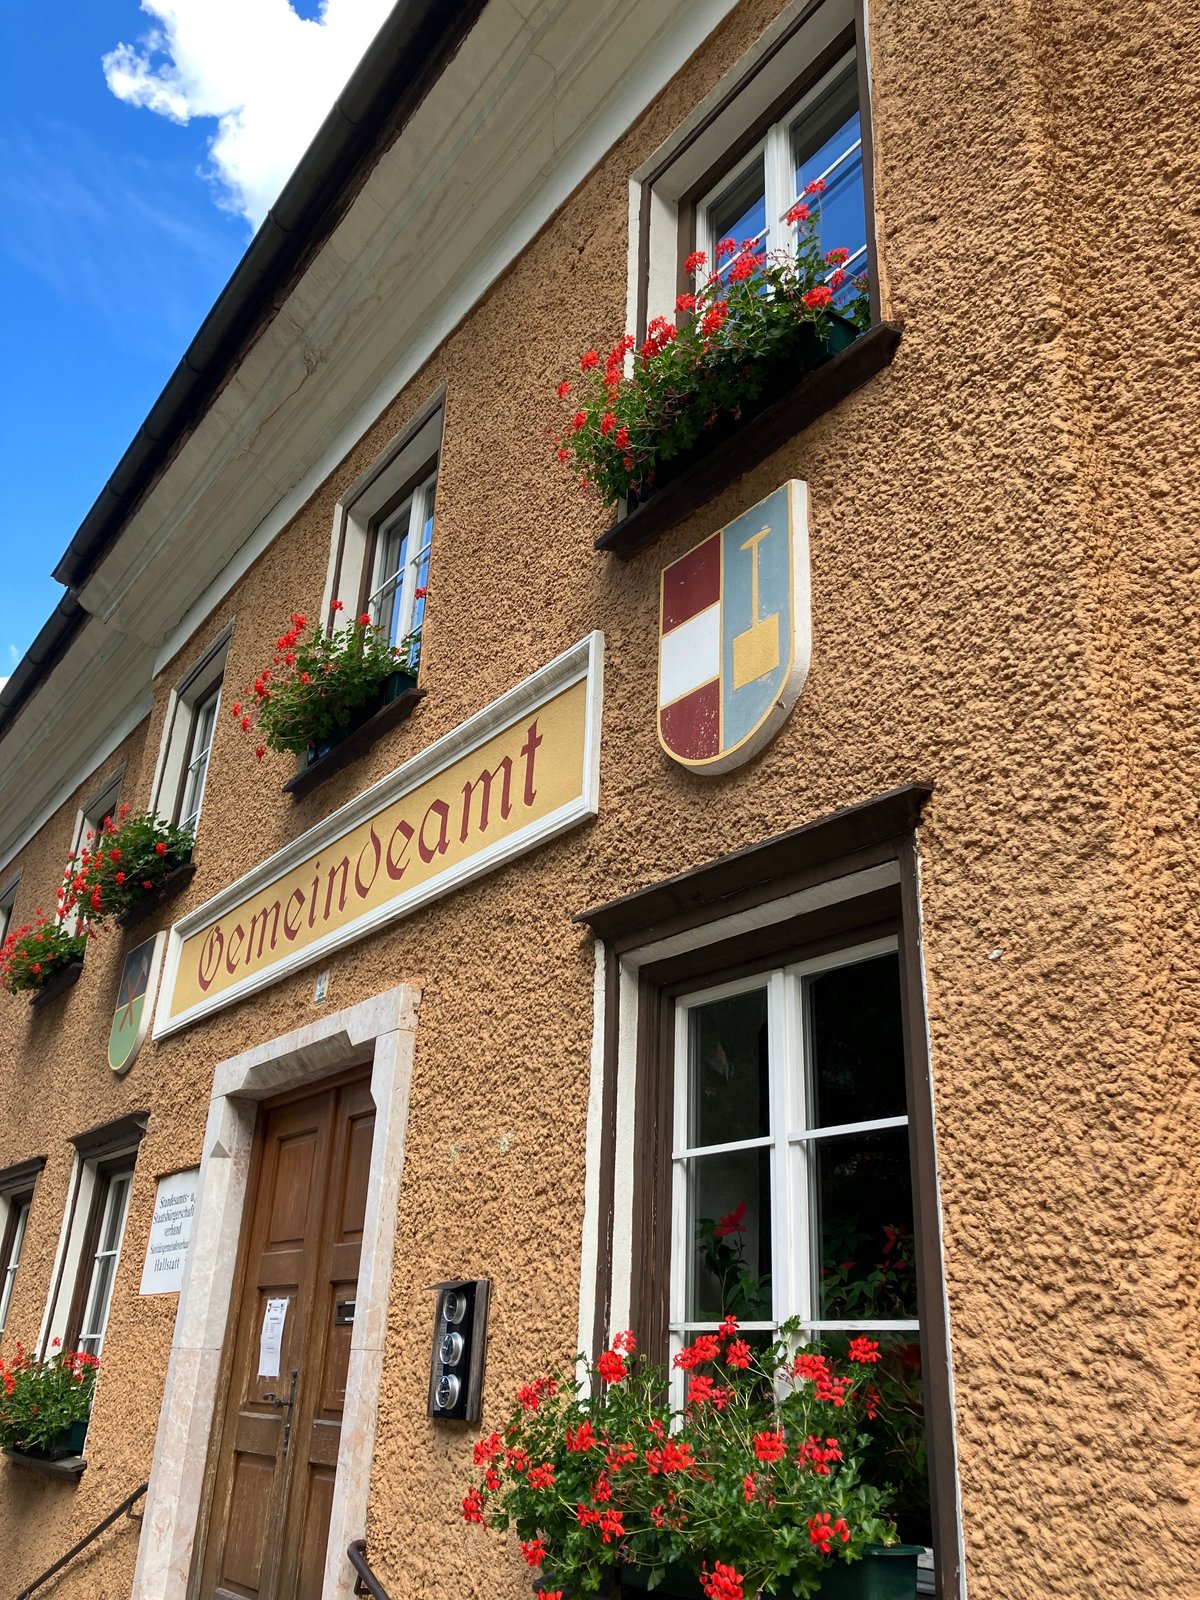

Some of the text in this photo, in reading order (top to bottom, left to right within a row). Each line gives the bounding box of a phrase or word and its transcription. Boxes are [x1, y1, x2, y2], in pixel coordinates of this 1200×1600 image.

[198, 716, 544, 992] Gemeindeamt
[164, 1222, 183, 1236] verband
[154, 1257, 180, 1272] Hallstatt
